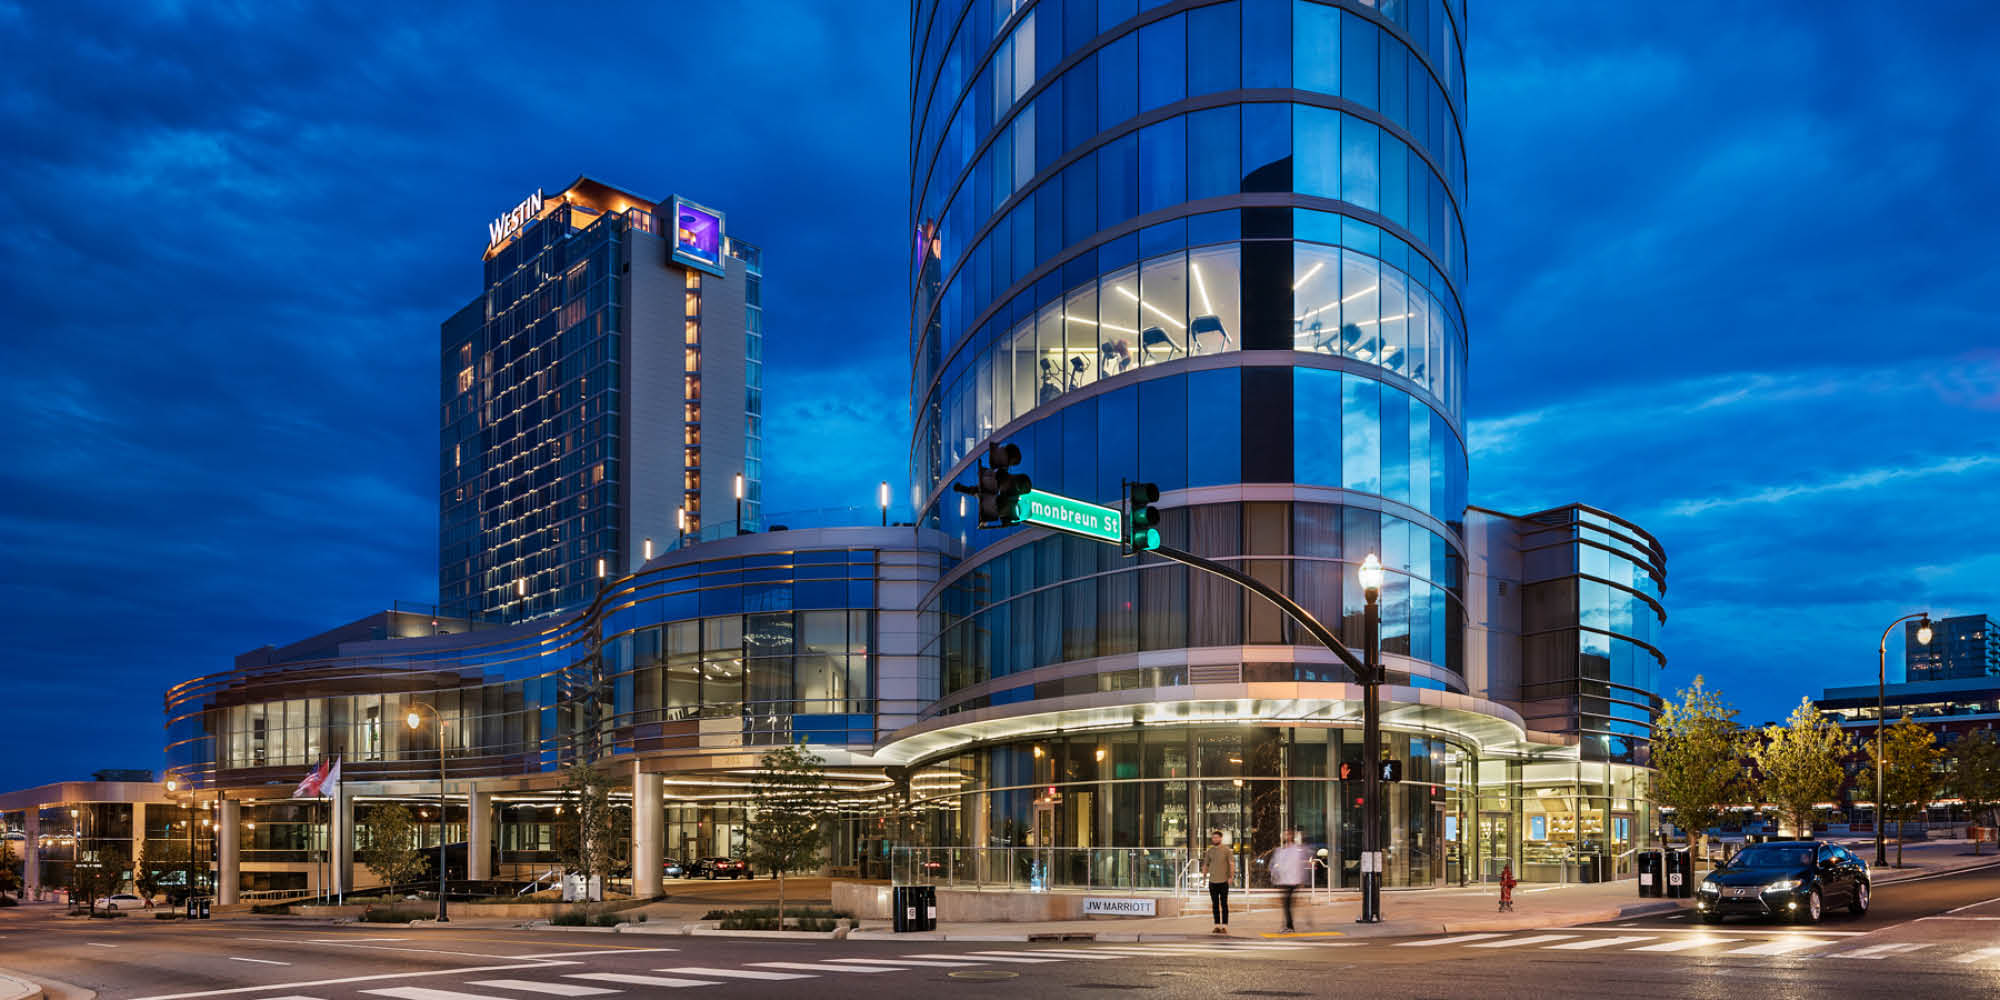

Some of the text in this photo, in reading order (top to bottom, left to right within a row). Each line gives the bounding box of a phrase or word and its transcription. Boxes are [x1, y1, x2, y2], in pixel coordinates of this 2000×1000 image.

[489, 187, 543, 248] WESTIN
[1031, 501, 1118, 533] monbreun St
[1087, 901, 1151, 913] JW MARRIOTT
